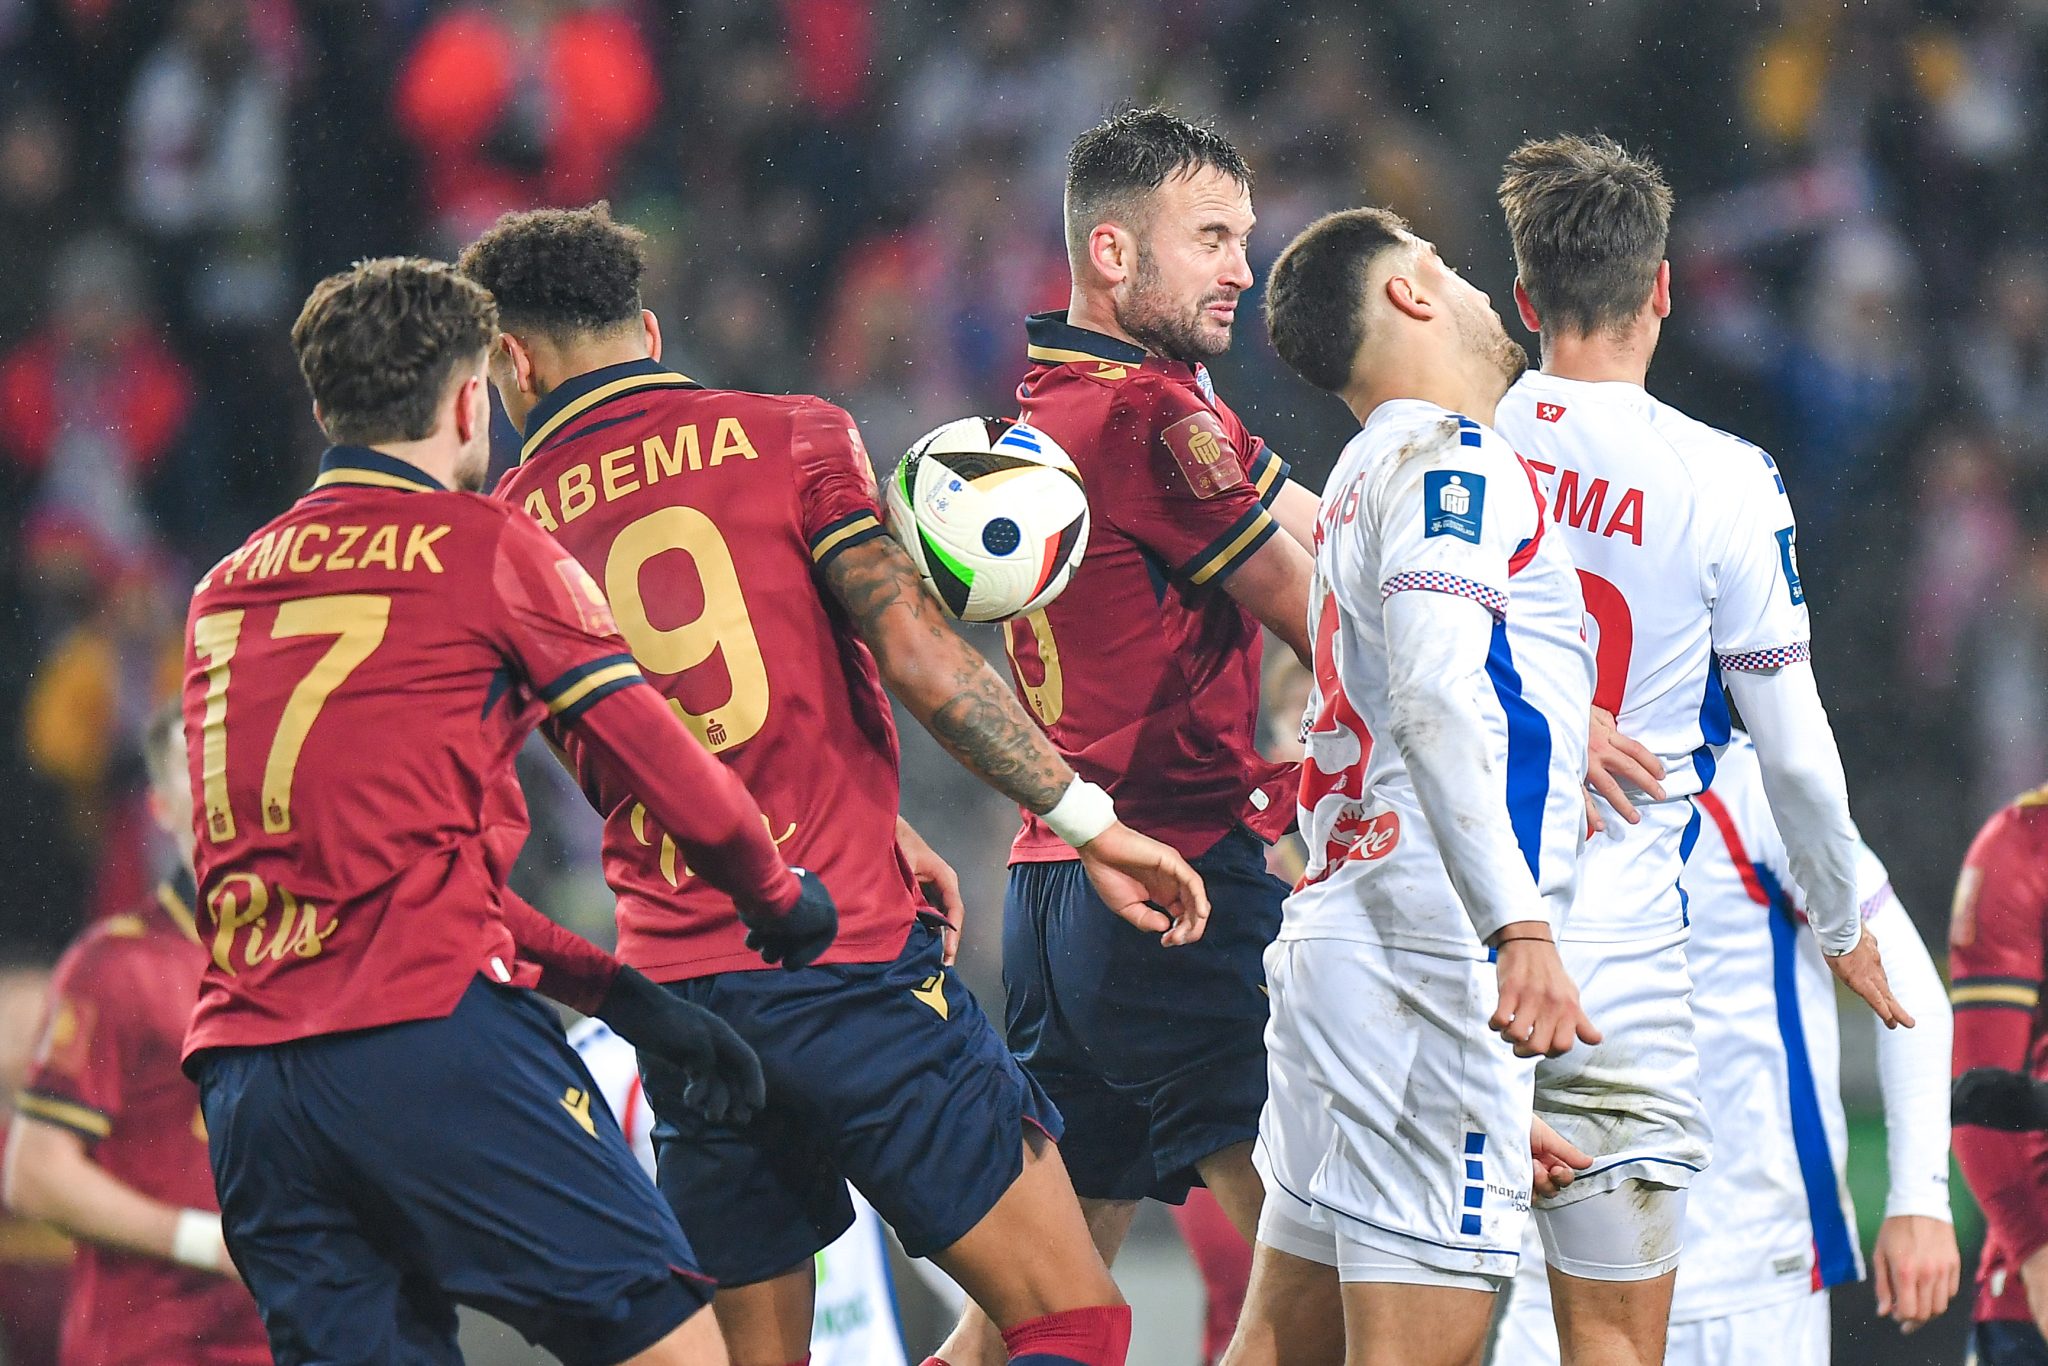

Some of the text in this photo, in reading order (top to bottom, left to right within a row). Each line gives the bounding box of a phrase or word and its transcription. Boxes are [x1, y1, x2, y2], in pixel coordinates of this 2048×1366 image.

[523, 416, 759, 533] ABEMA
[1527, 459, 1644, 547] MA
[604, 505, 769, 754] 9
[194, 593, 392, 843] 17
[207, 872, 340, 978] Pils
